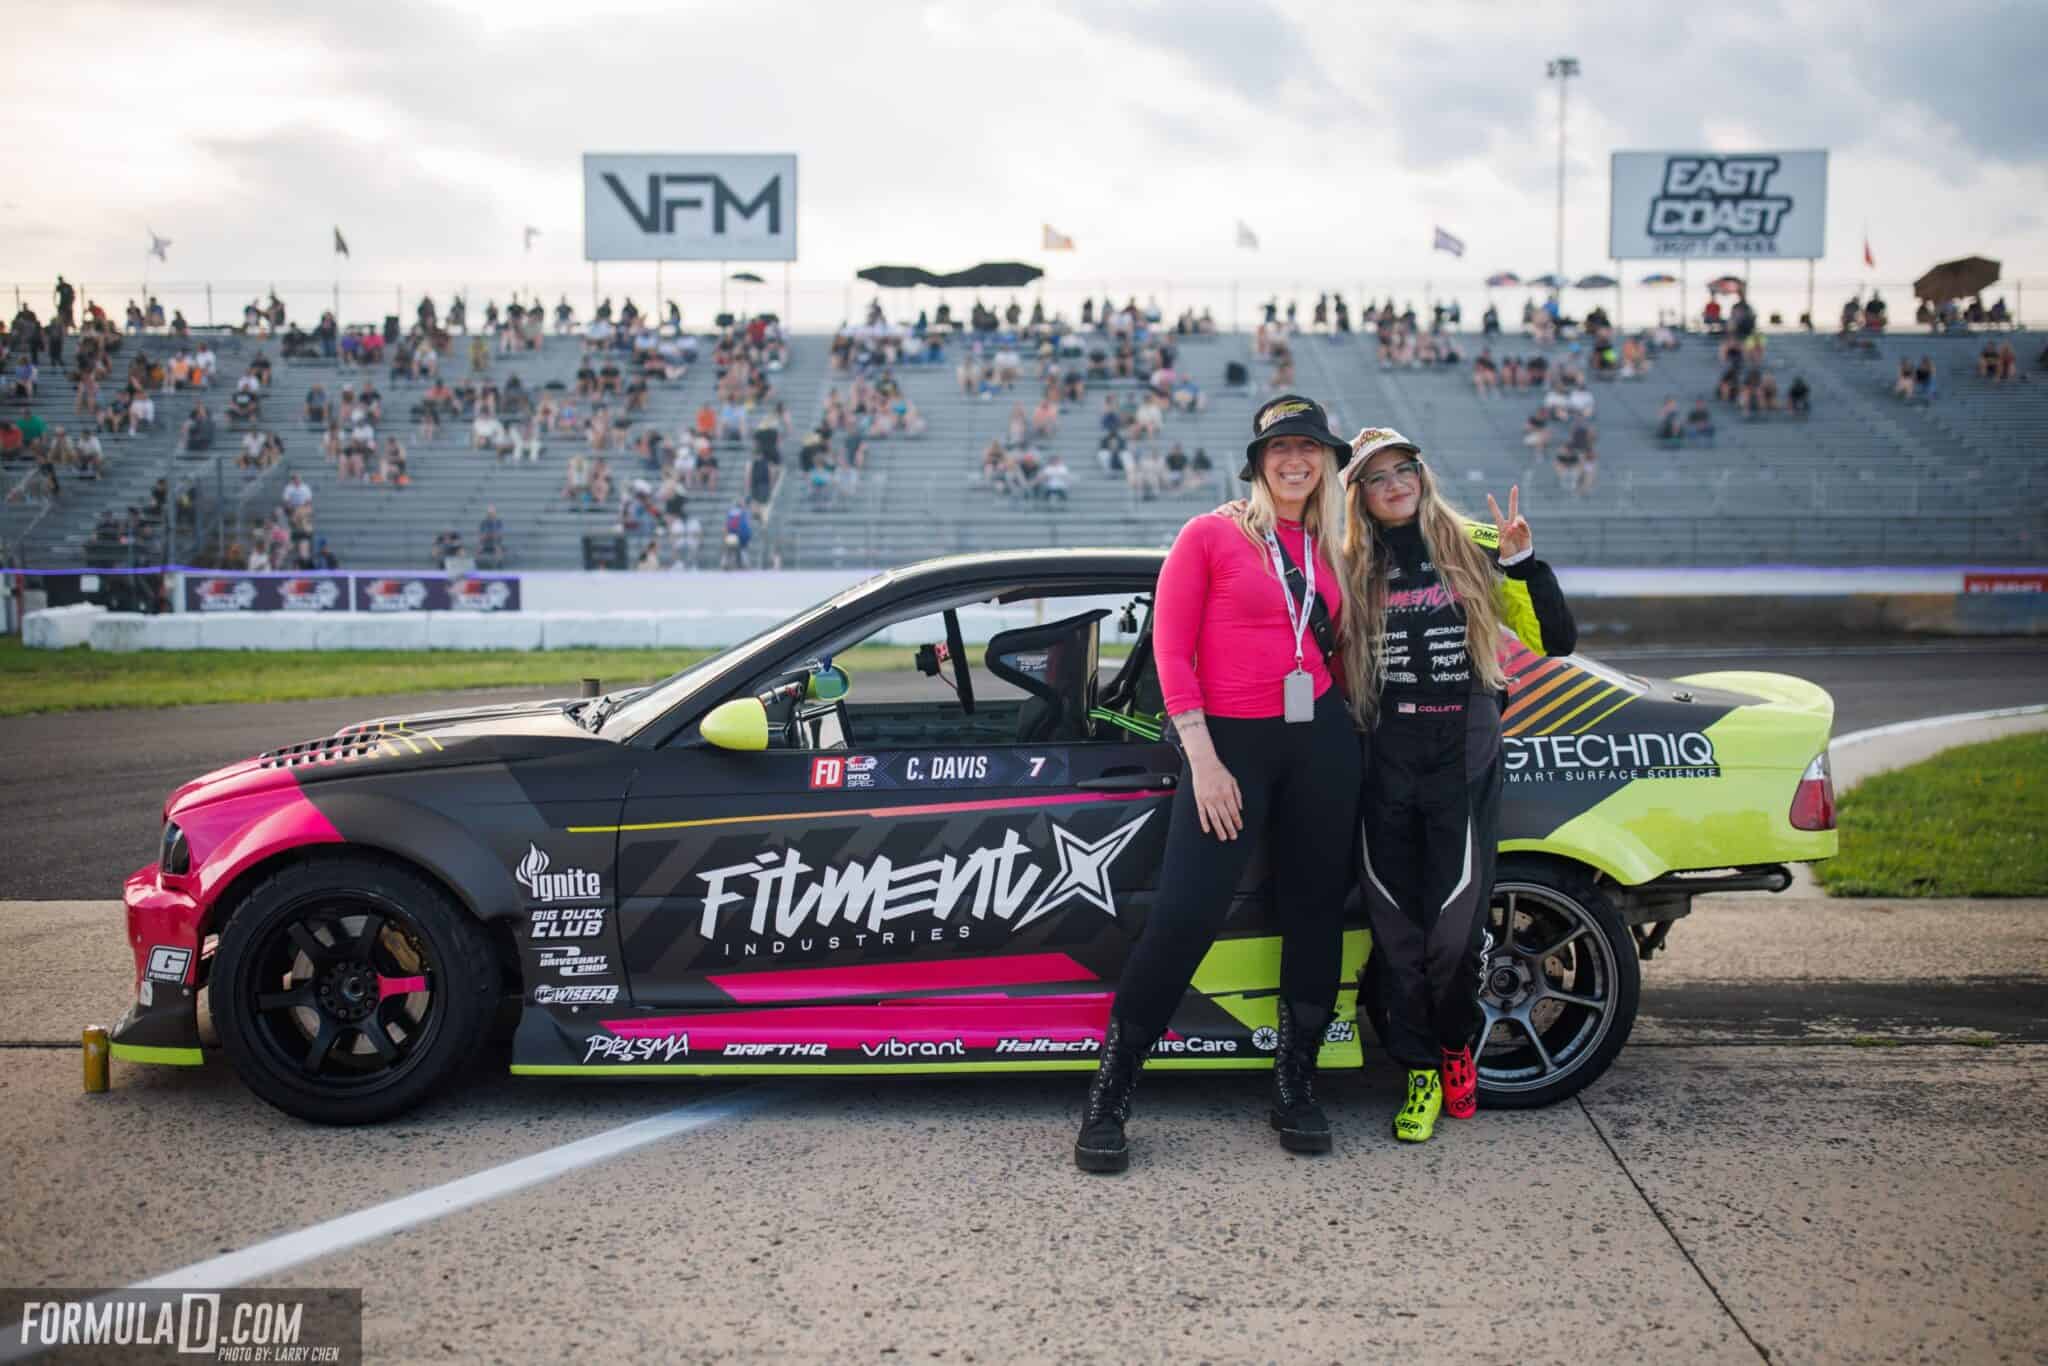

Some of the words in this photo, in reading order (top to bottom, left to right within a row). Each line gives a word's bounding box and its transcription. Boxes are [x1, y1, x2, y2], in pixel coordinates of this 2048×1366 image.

[1663, 158, 1779, 195] EAST
[601, 172, 781, 234] VFM
[1648, 197, 1792, 235] COAST
[931, 757, 987, 779] DAVIS
[1029, 758, 1046, 776] 7
[1503, 772, 1554, 782] MART
[1566, 769, 1638, 781] SURFACE
[1647, 769, 1717, 779] SCIENCE
[532, 910, 558, 921] BIG
[562, 909, 605, 920] DUCK
[531, 920, 603, 938] CLUB
[725, 926, 971, 955] INDUSTRIES
[723, 1043, 828, 1056] DRIFTHQ
[995, 1039, 1100, 1053] Haltech
[1151, 1037, 1238, 1052] ireCare
